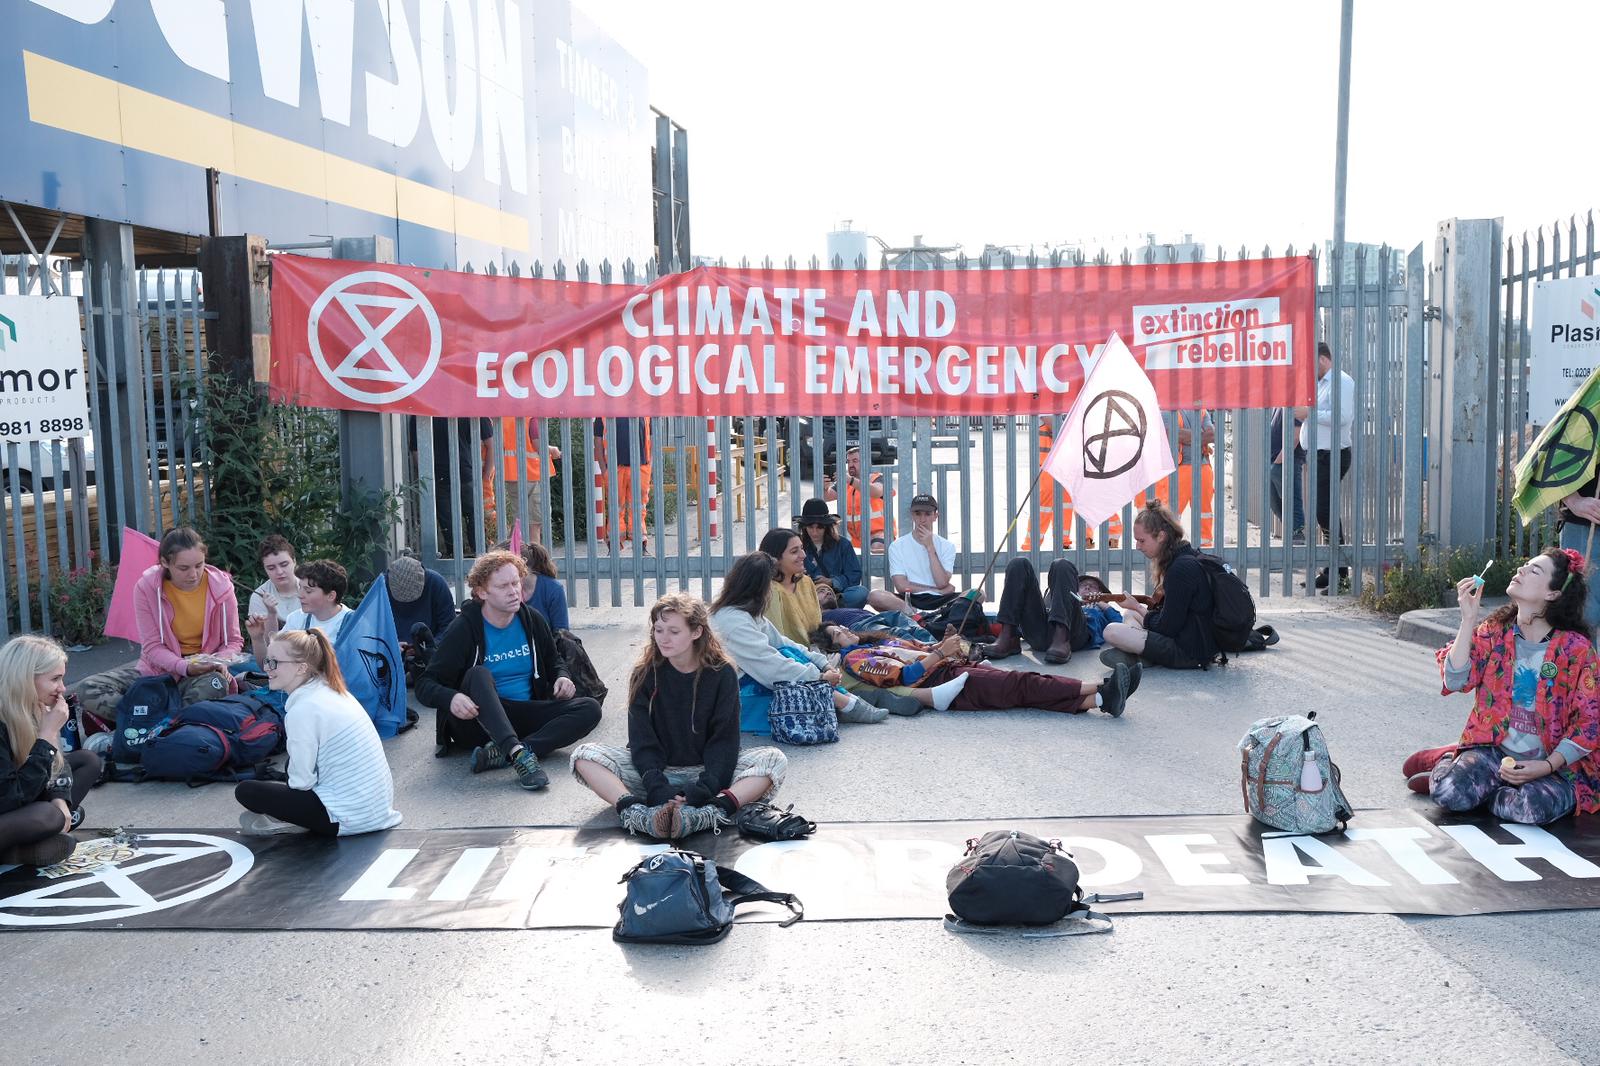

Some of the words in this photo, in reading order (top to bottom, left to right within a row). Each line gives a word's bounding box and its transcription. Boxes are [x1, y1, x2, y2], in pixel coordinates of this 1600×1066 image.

[556, 37, 623, 128] TIMBER
[622, 286, 826, 338] CLIMATE
[847, 289, 956, 338] AND
[1140, 304, 1260, 335] extinction
[476, 343, 785, 398] ECOLOGICAL
[805, 344, 1106, 396] EMERGENCY
[1177, 329, 1287, 364] rebellion
[40, 417, 84, 433] 8898
[1042, 822, 1600, 887] DEATH
